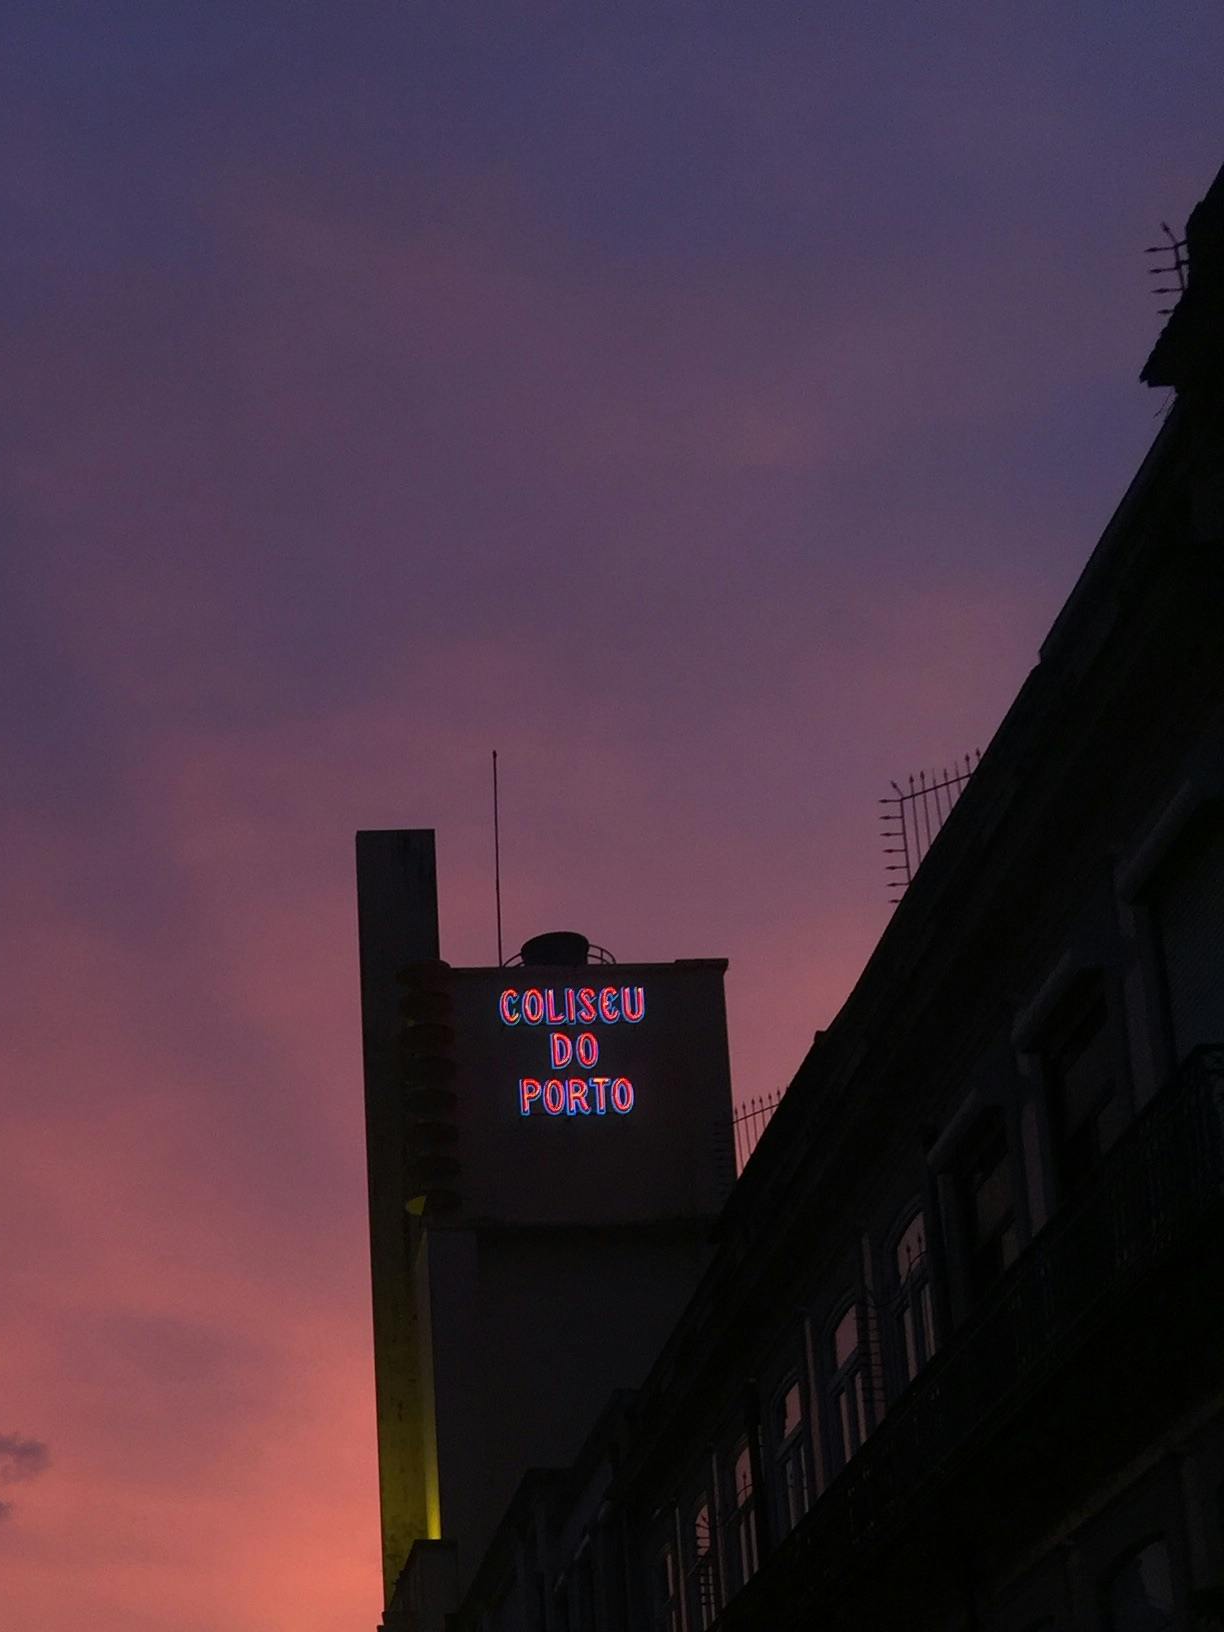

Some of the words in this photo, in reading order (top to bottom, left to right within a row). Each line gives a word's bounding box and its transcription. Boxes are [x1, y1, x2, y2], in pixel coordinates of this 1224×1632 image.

[499, 986, 645, 1026] COLISEU
[550, 1031, 599, 1070] DO
[519, 1076, 634, 1116] PORTO
